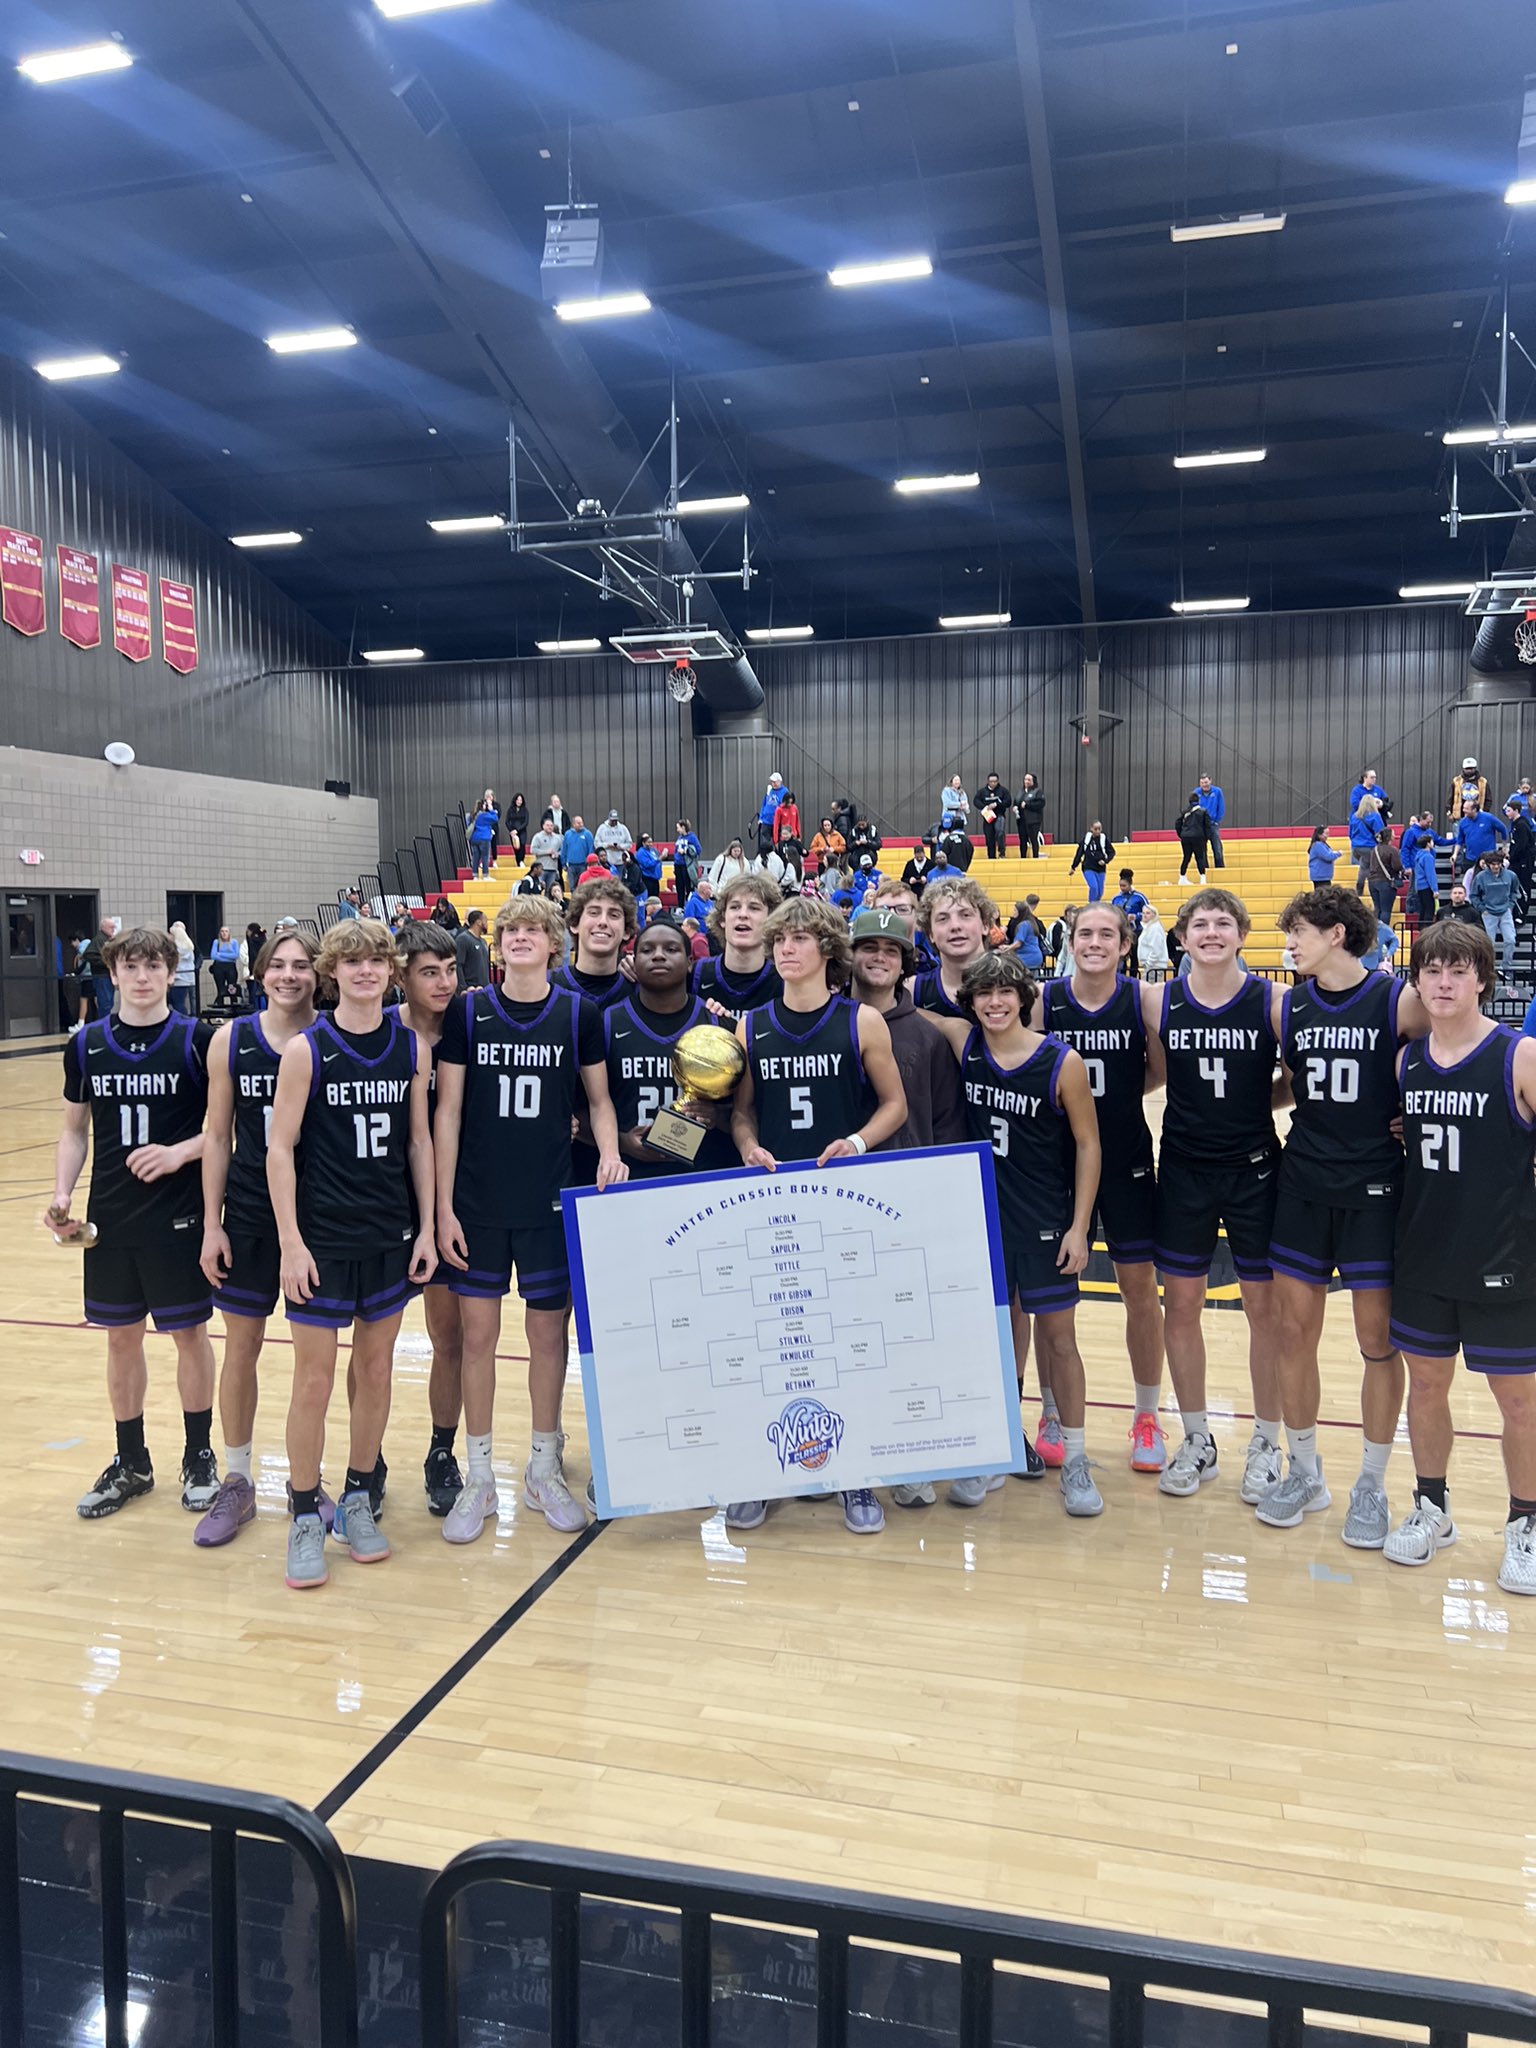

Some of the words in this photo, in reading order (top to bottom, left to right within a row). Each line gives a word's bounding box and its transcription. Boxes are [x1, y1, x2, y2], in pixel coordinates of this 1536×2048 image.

[1169, 1028, 1259, 1050] BETHANY
[1295, 1027, 1380, 1051] BETHANY
[477, 1043, 564, 1067] BETHANY
[621, 1056, 674, 1079] BETH
[759, 1054, 842, 1080] BETHANY
[91, 1073, 180, 1097] BETHANY
[1198, 1057, 1227, 1098] 4
[1306, 1057, 1359, 1102] 20
[326, 1080, 409, 1106] BETHANY
[498, 1074, 541, 1118] 10
[965, 1081, 1042, 1118] BETHANY
[1405, 1090, 1489, 1117] BETHANY
[789, 1086, 814, 1130] 5
[119, 1104, 149, 1146] 11
[353, 1112, 391, 1158] 12
[990, 1115, 1009, 1157] 3
[1420, 1123, 1460, 1172] 21
[665, 1207, 714, 1247] WINTER
[720, 1186, 782, 1210] CLASSIC
[790, 1184, 828, 1195] BOYS
[836, 1188, 902, 1222] BRACKET
[768, 1214, 797, 1226] LINCOLN
[770, 1243, 801, 1255] SAPULPA
[774, 1260, 800, 1272] TUTTLE
[769, 1291, 786, 1303] FORT
[788, 1288, 813, 1300] GIBSON
[780, 1305, 805, 1317] EDISON
[779, 1334, 813, 1347] STILWELL
[780, 1350, 815, 1362] OKMULGEE
[785, 1379, 816, 1391] BETHANY
[767, 1406, 844, 1474] Winter
[794, 1443, 828, 1461] CLASSIC
